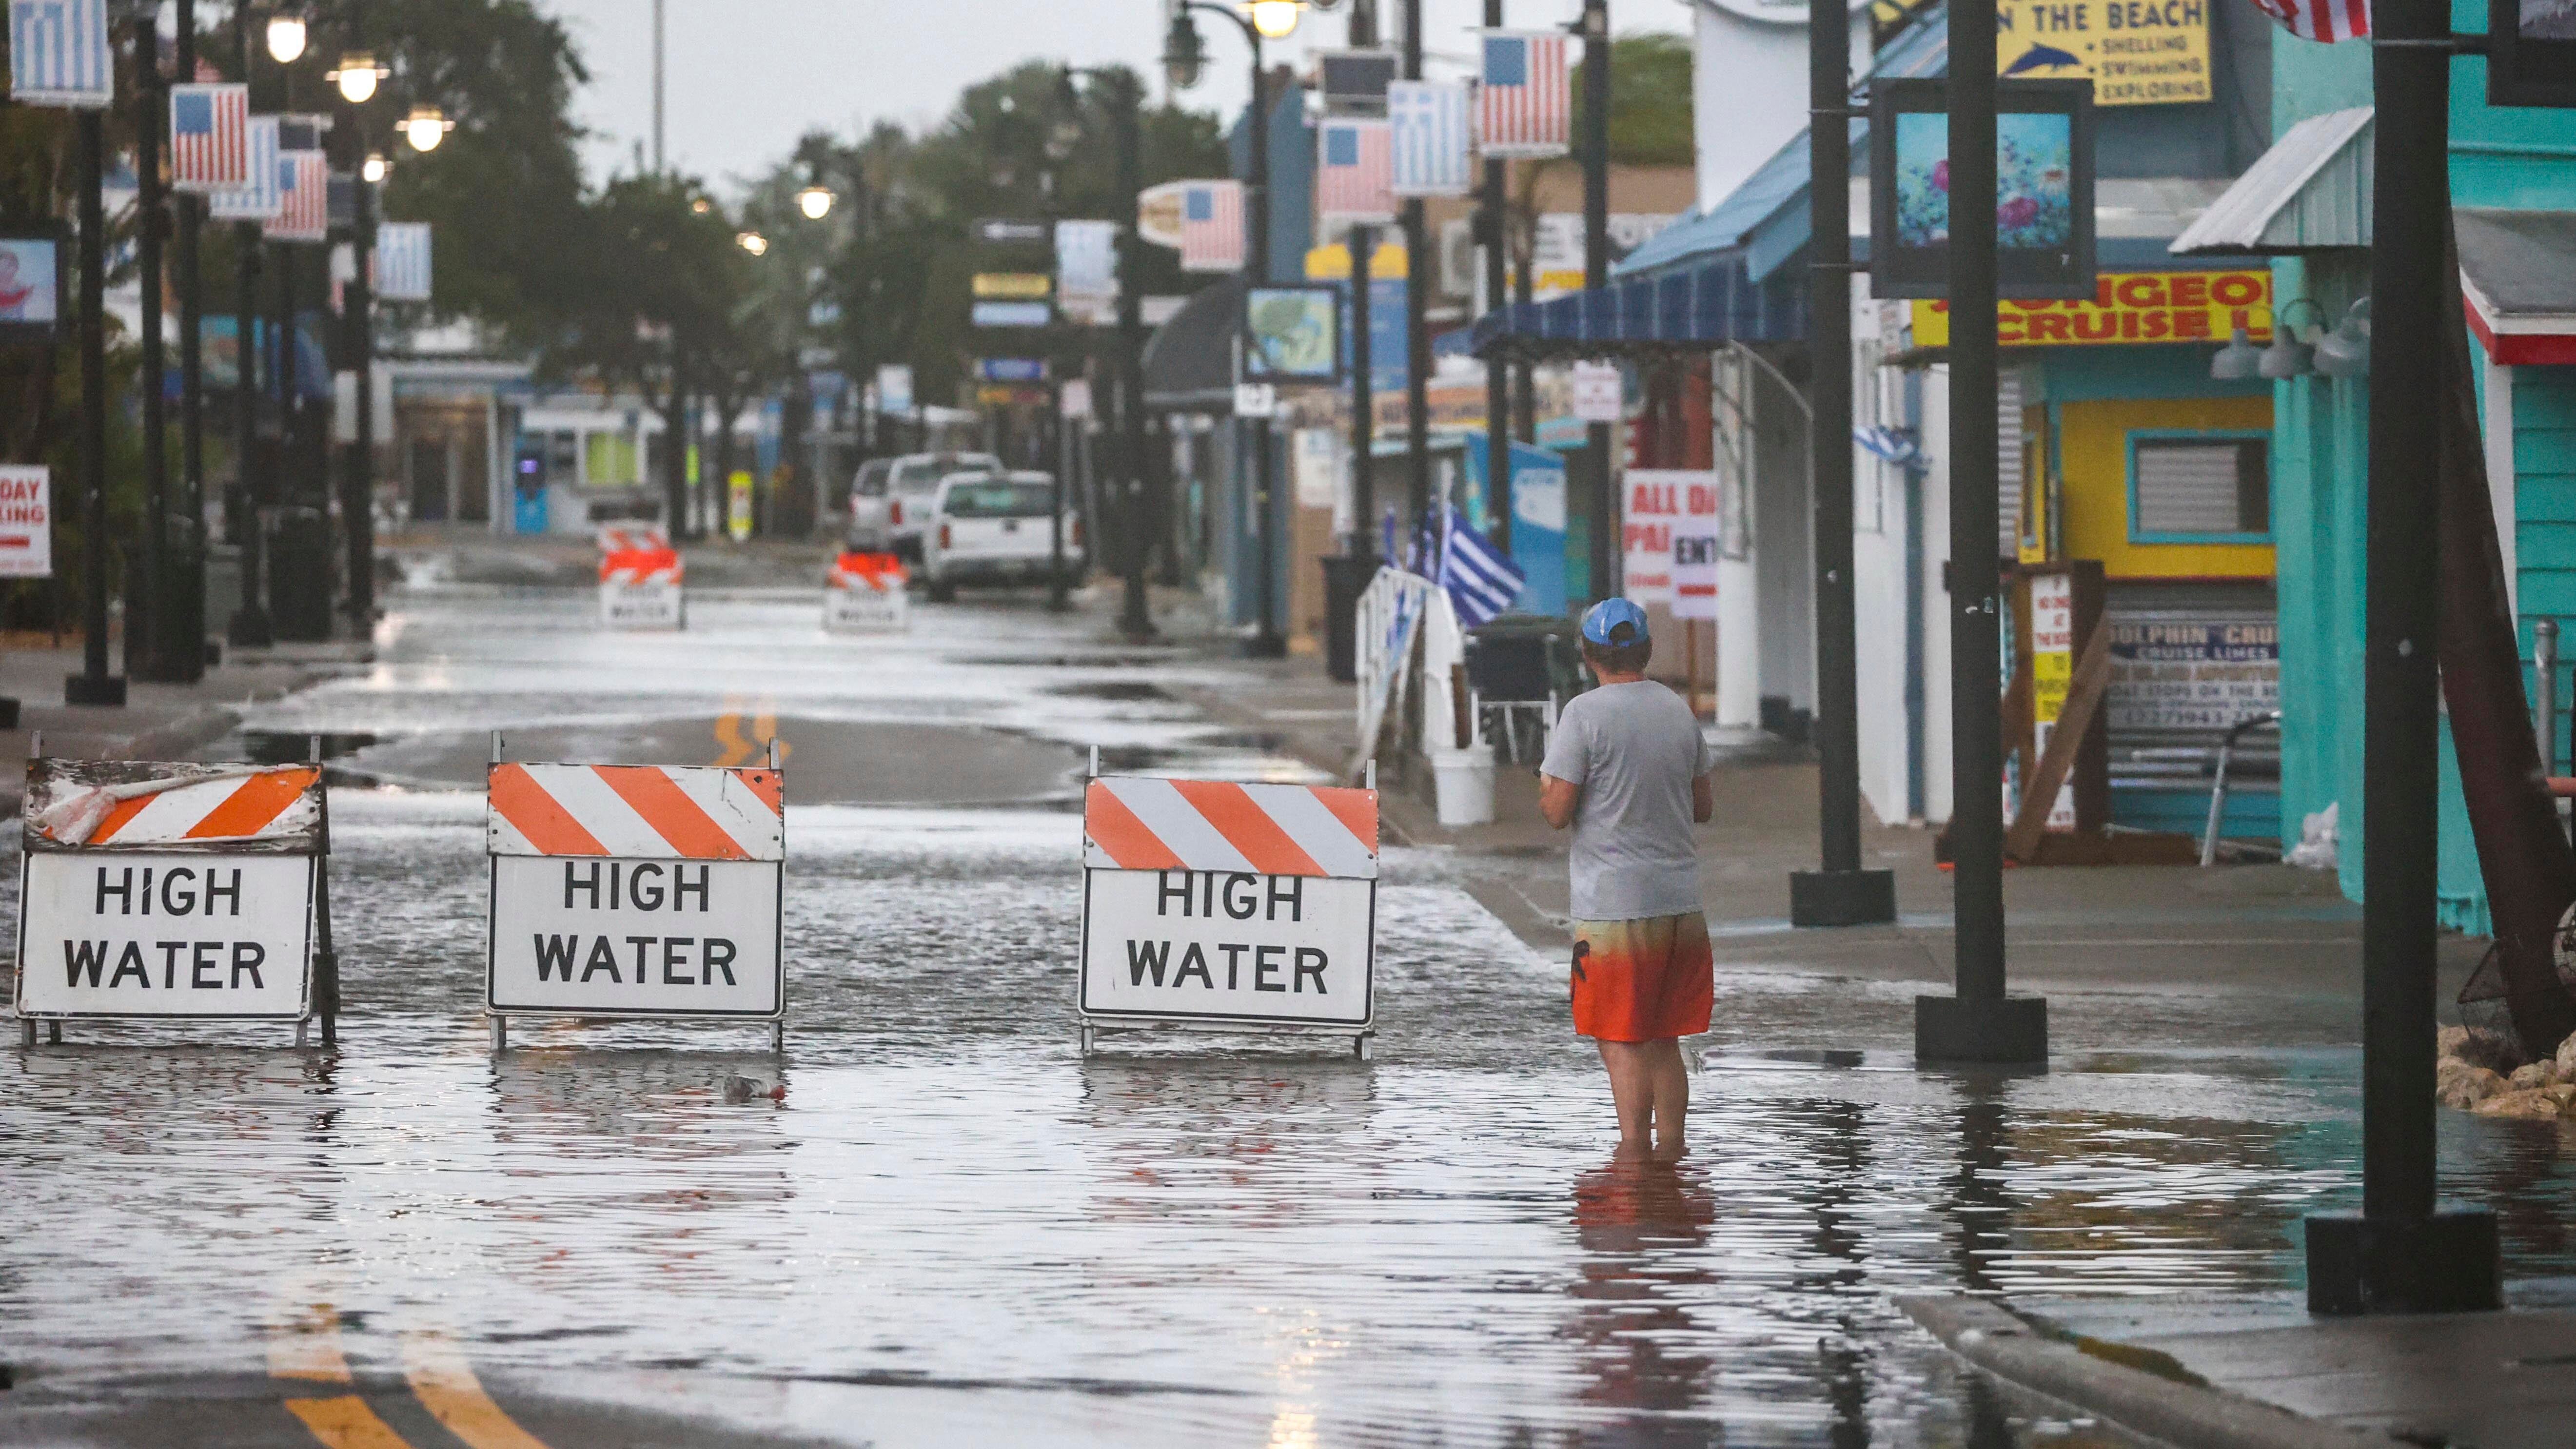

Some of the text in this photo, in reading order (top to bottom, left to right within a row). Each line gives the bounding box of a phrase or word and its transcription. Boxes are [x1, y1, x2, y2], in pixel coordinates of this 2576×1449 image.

[1997, 0, 2202, 33] N THE BEACH
[2102, 35, 2187, 54] SHELLING
[2102, 57, 2202, 77] SWIMMING
[2102, 80, 2205, 100] EXPLORING
[1998, 308, 2269, 340] CRUISE L
[0, 478, 40, 501] DAY
[1633, 483, 1679, 515] ALL
[1675, 536, 1717, 565] ENT
[2225, 626, 2275, 644] CRU
[96, 866, 241, 916] HIGH
[564, 861, 709, 912] HIGH
[1157, 870, 1302, 922] HIGH
[64, 939, 266, 989] WATER
[533, 933, 737, 986] WATER
[1126, 939, 1329, 995] WATER
